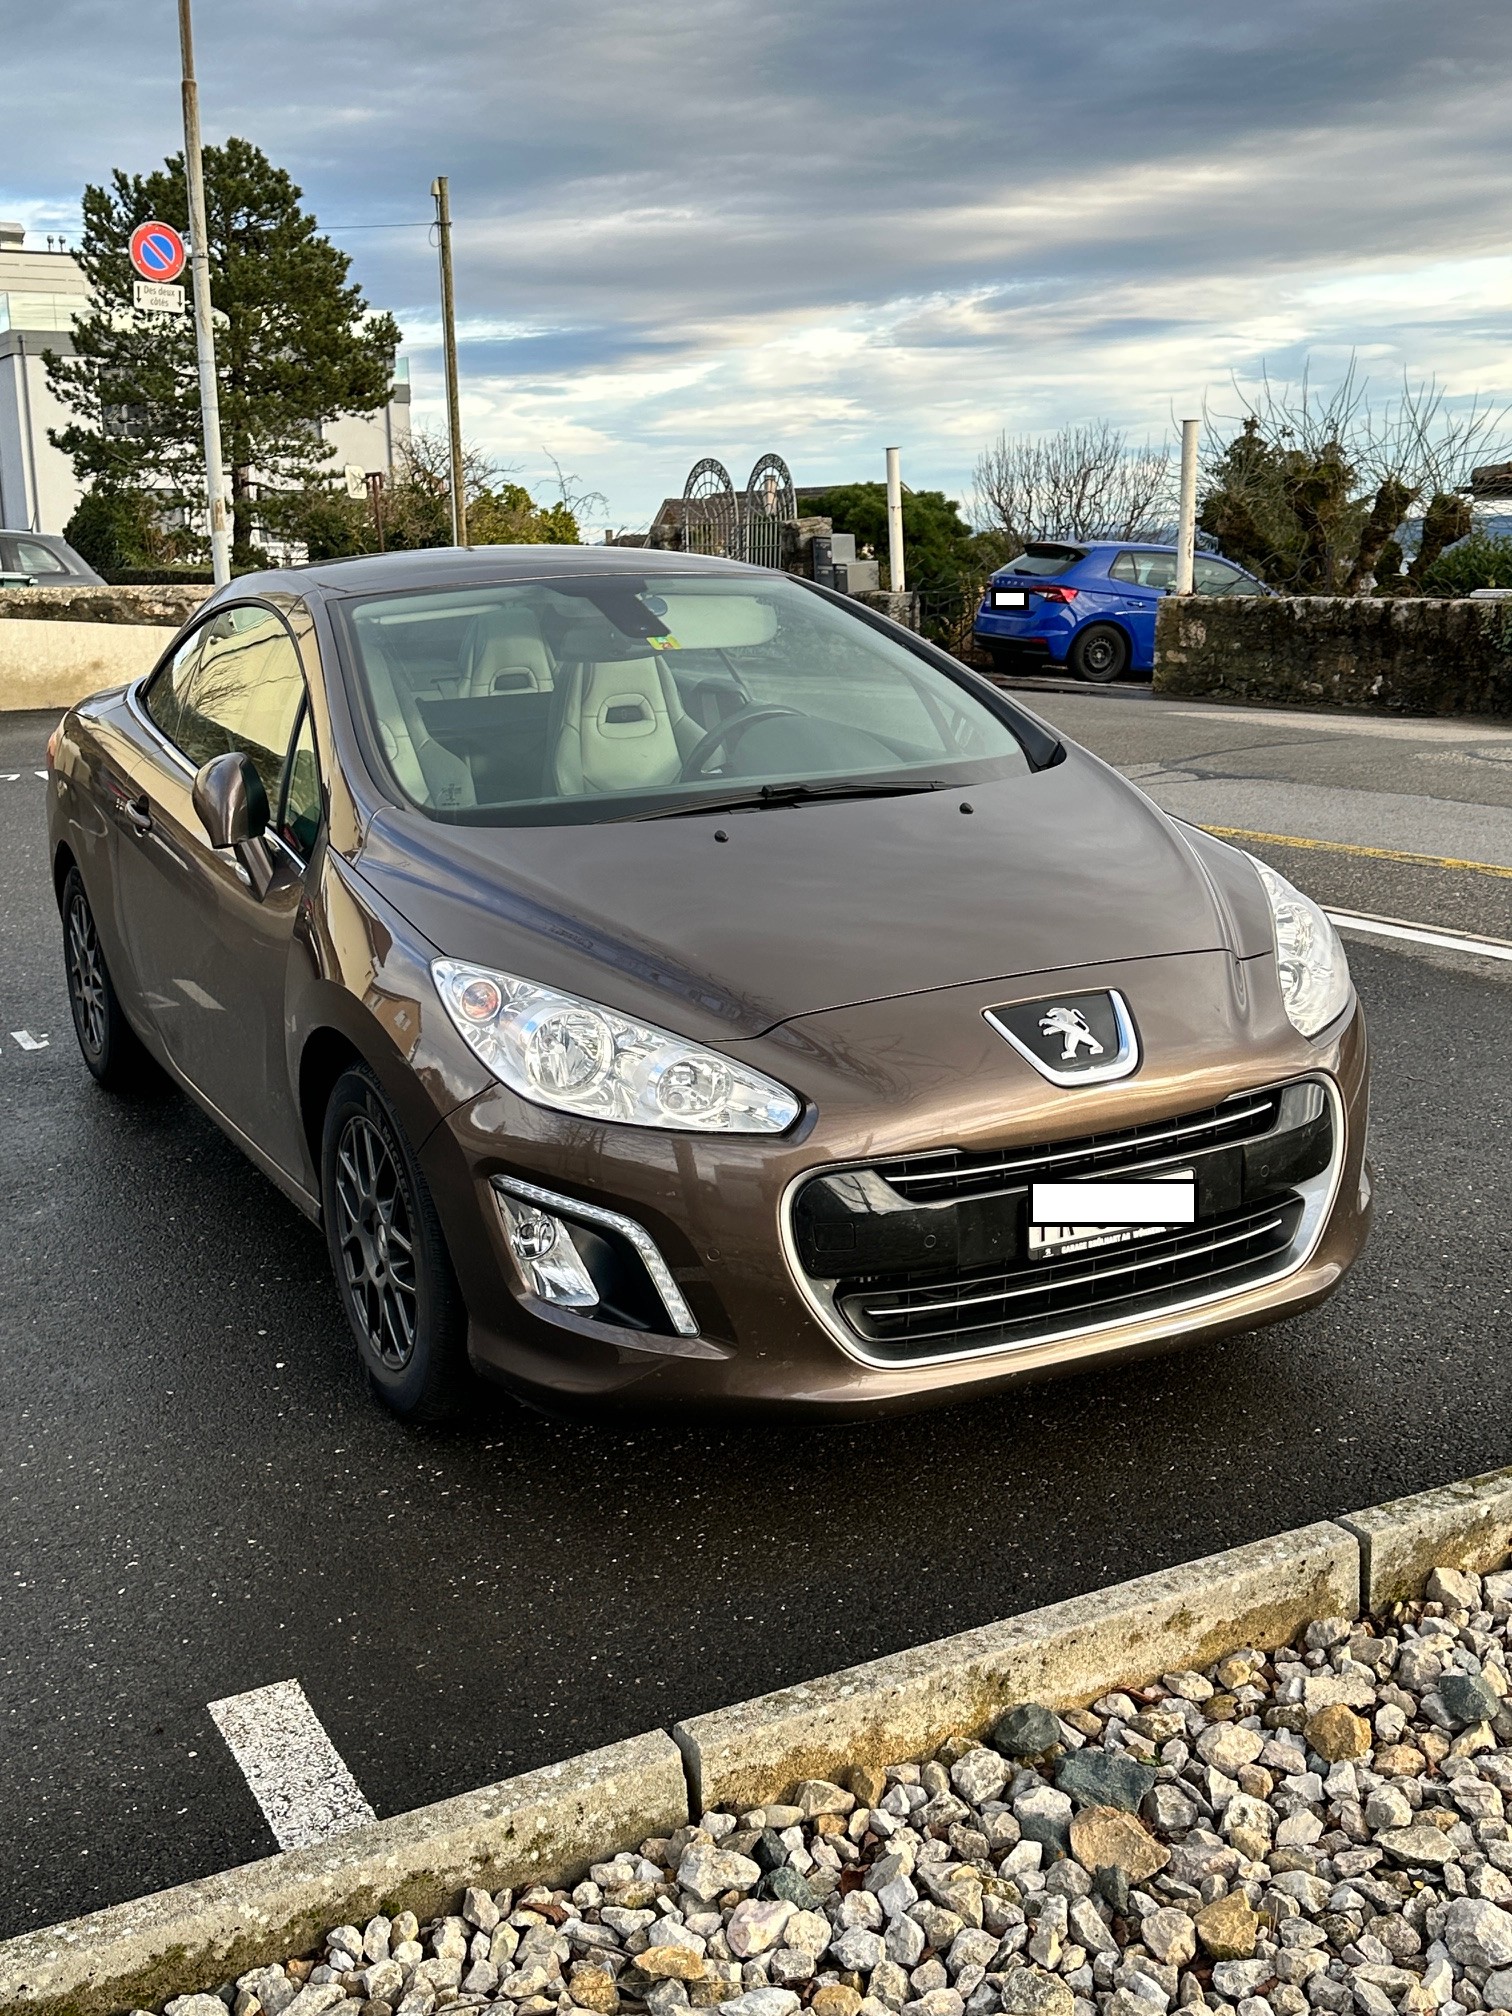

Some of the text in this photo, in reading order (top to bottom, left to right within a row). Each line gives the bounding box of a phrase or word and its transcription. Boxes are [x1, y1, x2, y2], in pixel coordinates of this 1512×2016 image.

[144, 285, 175, 297] Des deux
[150, 297, 169, 307] côtés
[1061, 1241, 1087, 1254] GARAGE
